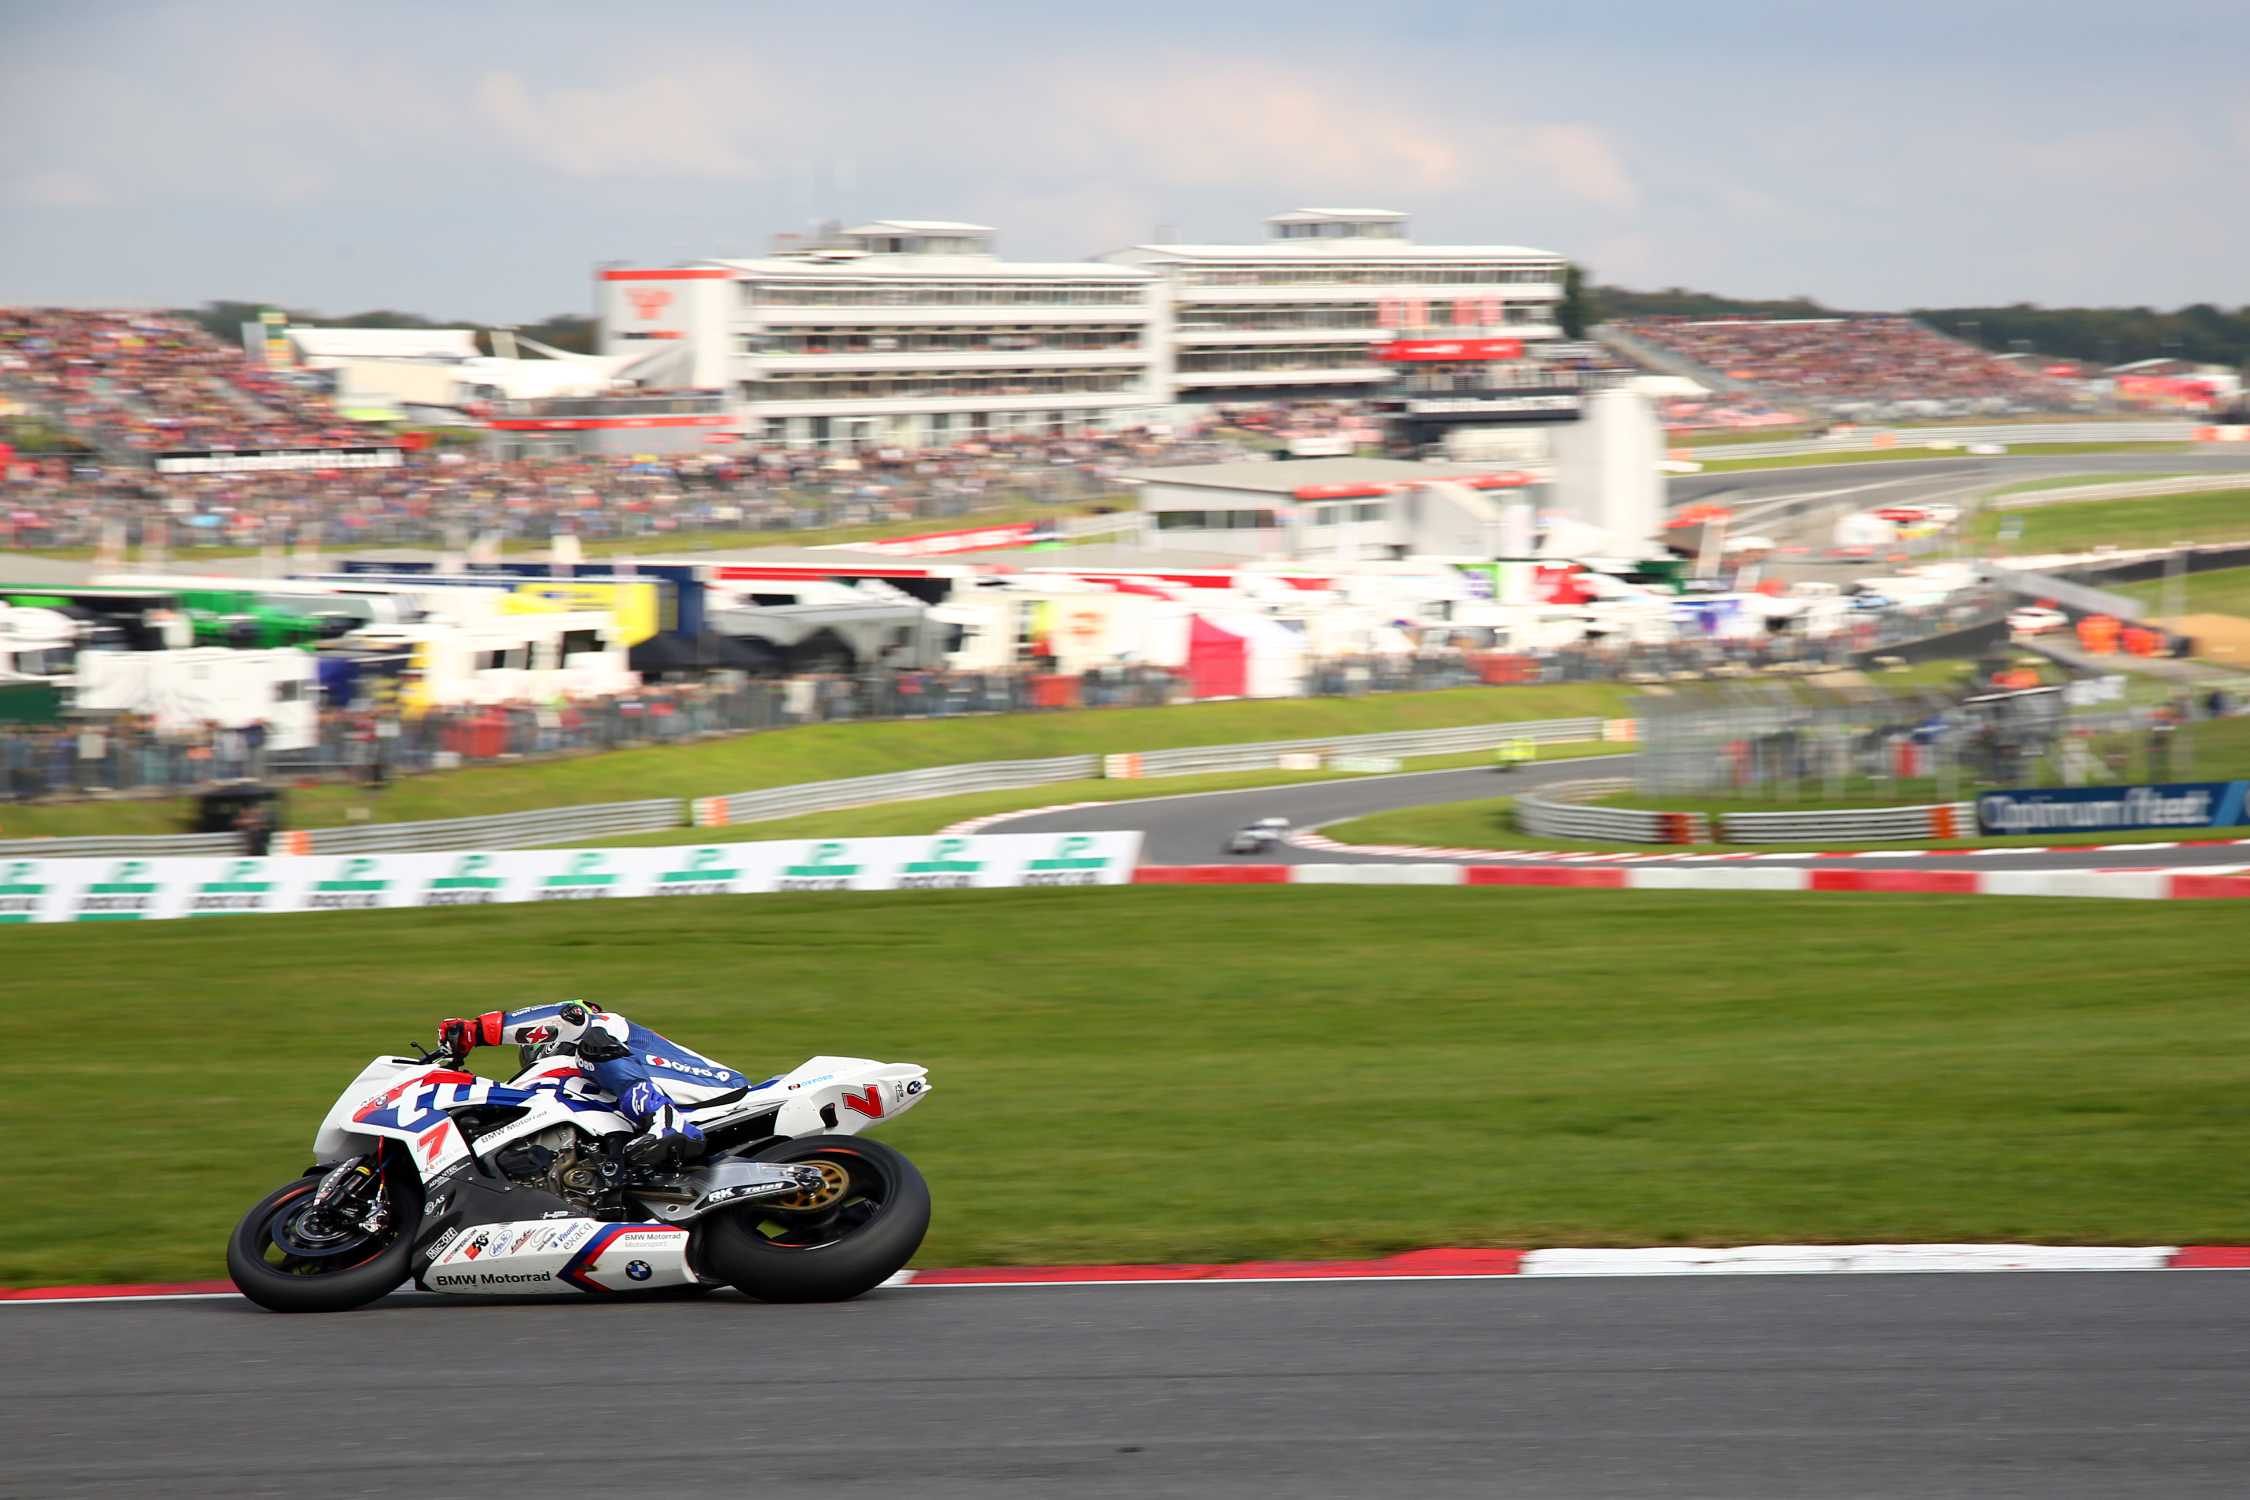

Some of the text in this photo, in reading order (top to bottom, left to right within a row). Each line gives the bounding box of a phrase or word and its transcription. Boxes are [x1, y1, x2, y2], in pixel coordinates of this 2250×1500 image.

[842, 1083, 885, 1119] 7
[417, 1121, 450, 1164] 7
[480, 1128, 505, 1143] BMW
[708, 1187, 735, 1203] RK
[625, 1232, 682, 1241] BMW Motorrad
[437, 1271, 551, 1287] BMW Motorrad
